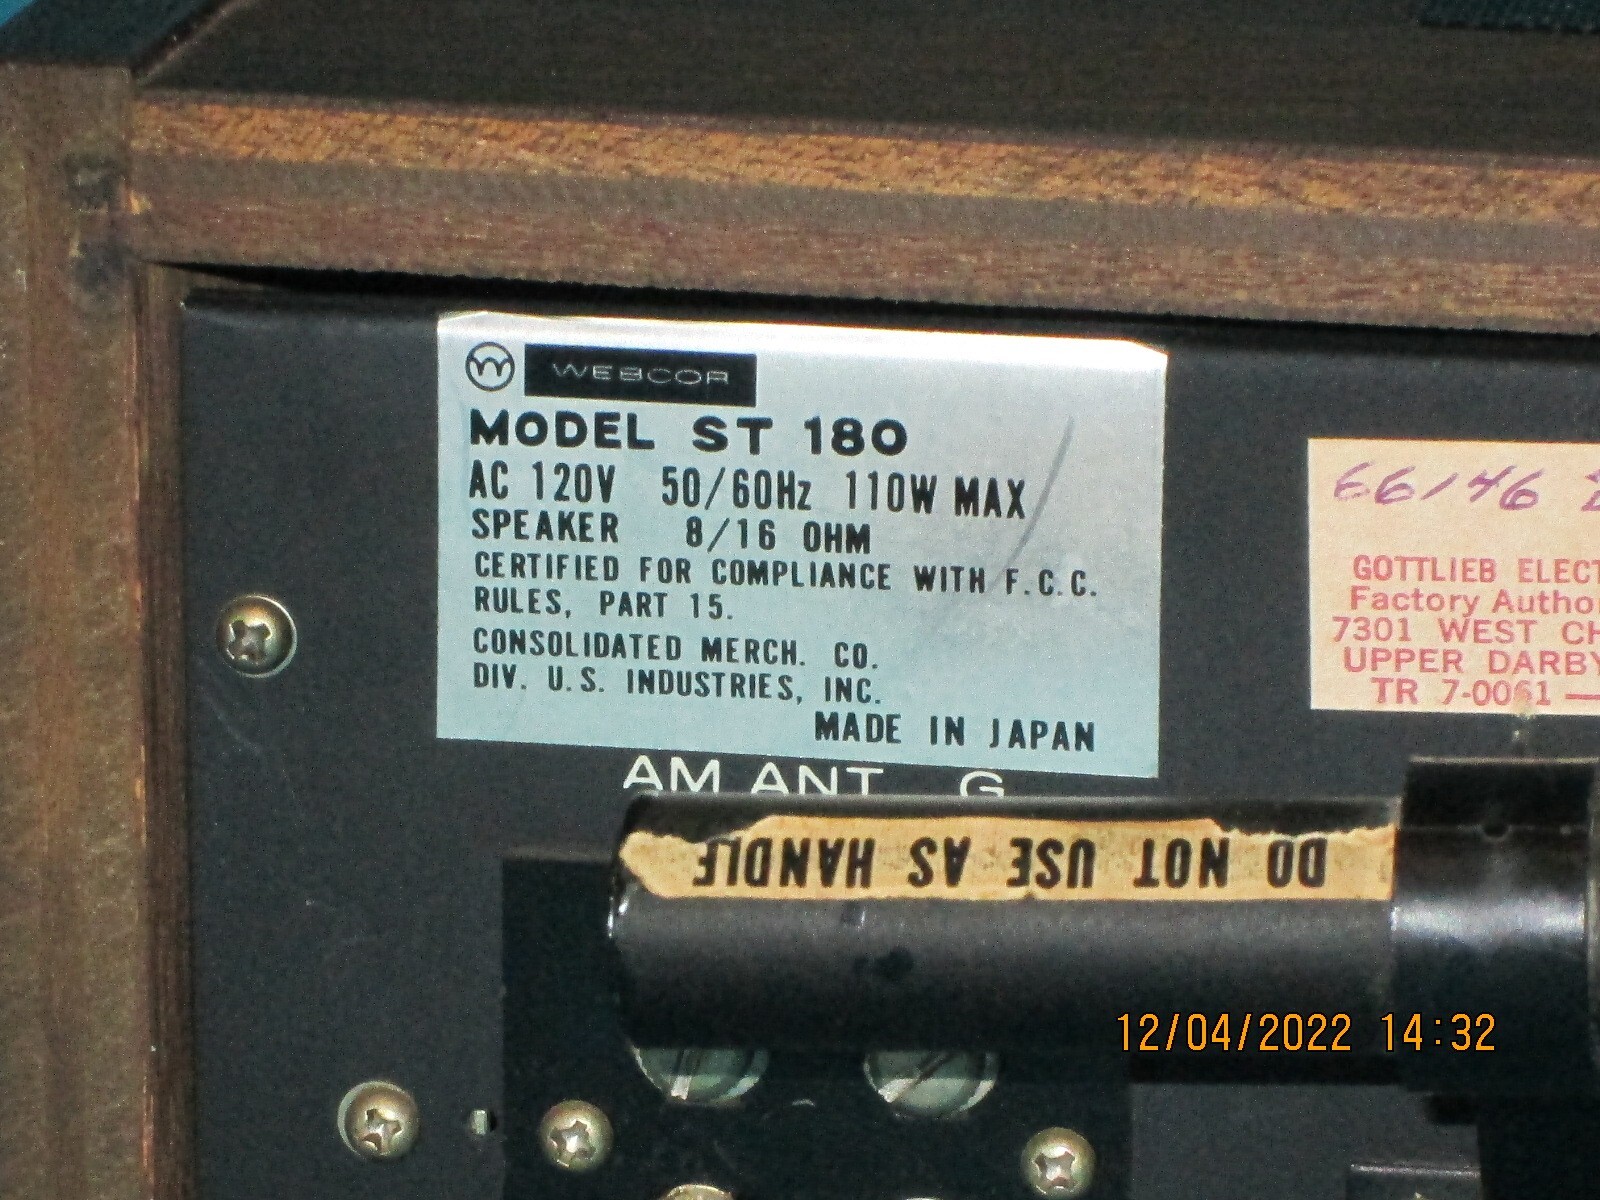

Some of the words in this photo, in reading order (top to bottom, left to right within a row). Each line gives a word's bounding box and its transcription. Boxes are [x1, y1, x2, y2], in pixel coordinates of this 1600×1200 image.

[552, 362, 729, 386] WEBCOR
[470, 408, 655, 450] MODEL
[692, 415, 773, 455] ST
[804, 415, 907, 456] 180
[469, 459, 509, 500] AC
[533, 461, 616, 503] 120V
[661, 465, 812, 511] 50/60Hz
[846, 471, 937, 514] 110W
[954, 475, 1025, 519] MAX
[471, 508, 620, 543] SPEAKER
[685, 515, 776, 552] 8/16
[803, 521, 871, 554] OHM
[474, 551, 619, 582] CERTIFIED
[639, 556, 691, 584] FOR
[712, 558, 891, 590] COMPLIANCE
[914, 564, 985, 594] WITH
[1352, 554, 1498, 583] GOTTLIEB
[474, 586, 572, 619] RULES,
[599, 590, 668, 618] PART
[690, 593, 734, 620] 15.
[1350, 585, 1480, 617] Factory
[1491, 589, 1600, 615] Autho
[473, 627, 682, 661] CONSOLIDATED
[701, 636, 806, 667] MERCH.
[834, 641, 878, 669] CO.
[1332, 616, 1412, 642] 7301
[1438, 617, 1538, 644] WEST
[1343, 646, 1465, 674] UPPER
[473, 661, 527, 690] DIV.
[627, 669, 803, 706] INDUSTRIES,
[824, 676, 881, 705] INC.
[1371, 677, 1418, 705] TR
[1441, 679, 1552, 706] 7-0061
[814, 711, 901, 744] MADE
[930, 715, 965, 746] IN
[988, 718, 1095, 752] JAPAN
[623, 754, 720, 794] AM
[750, 762, 884, 797] ANT
[959, 770, 1005, 799] G
[907, 836, 971, 888] AS
[1006, 837, 1096, 889] USE
[1133, 836, 1230, 888] NOT
[1267, 837, 1328, 888] DO
